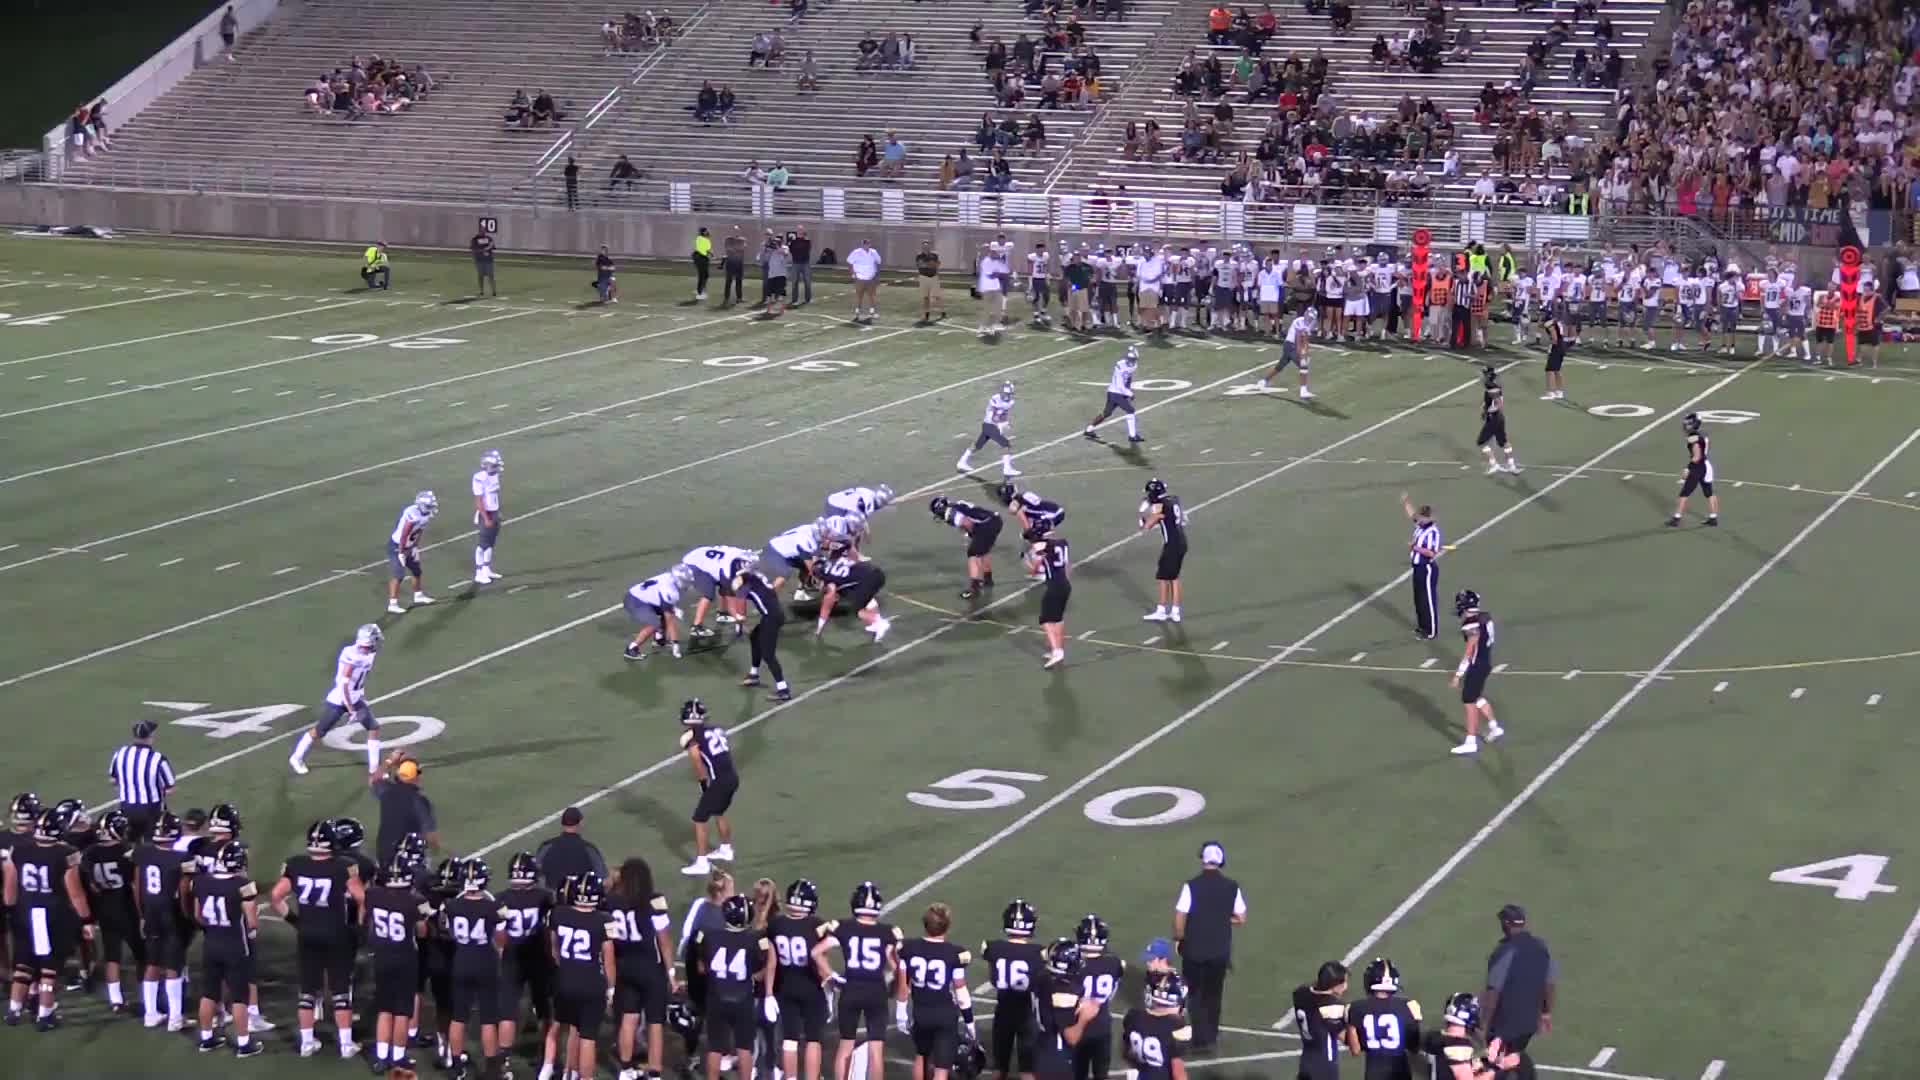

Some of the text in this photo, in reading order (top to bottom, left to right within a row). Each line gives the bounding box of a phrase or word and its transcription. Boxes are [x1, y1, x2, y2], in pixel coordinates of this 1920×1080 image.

[21, 863, 53, 893] 61
[146, 864, 162, 895] 8
[297, 876, 333, 908] 77
[202, 896, 231, 927] 41
[373, 907, 406, 942] 56
[557, 925, 592, 960] 72
[847, 936, 882, 971] 15
[710, 946, 747, 981] 44
[909, 956, 947, 990] 33
[996, 958, 1030, 992] 16
[1083, 974, 1114, 1004] 19
[1362, 1013, 1401, 1049] 13
